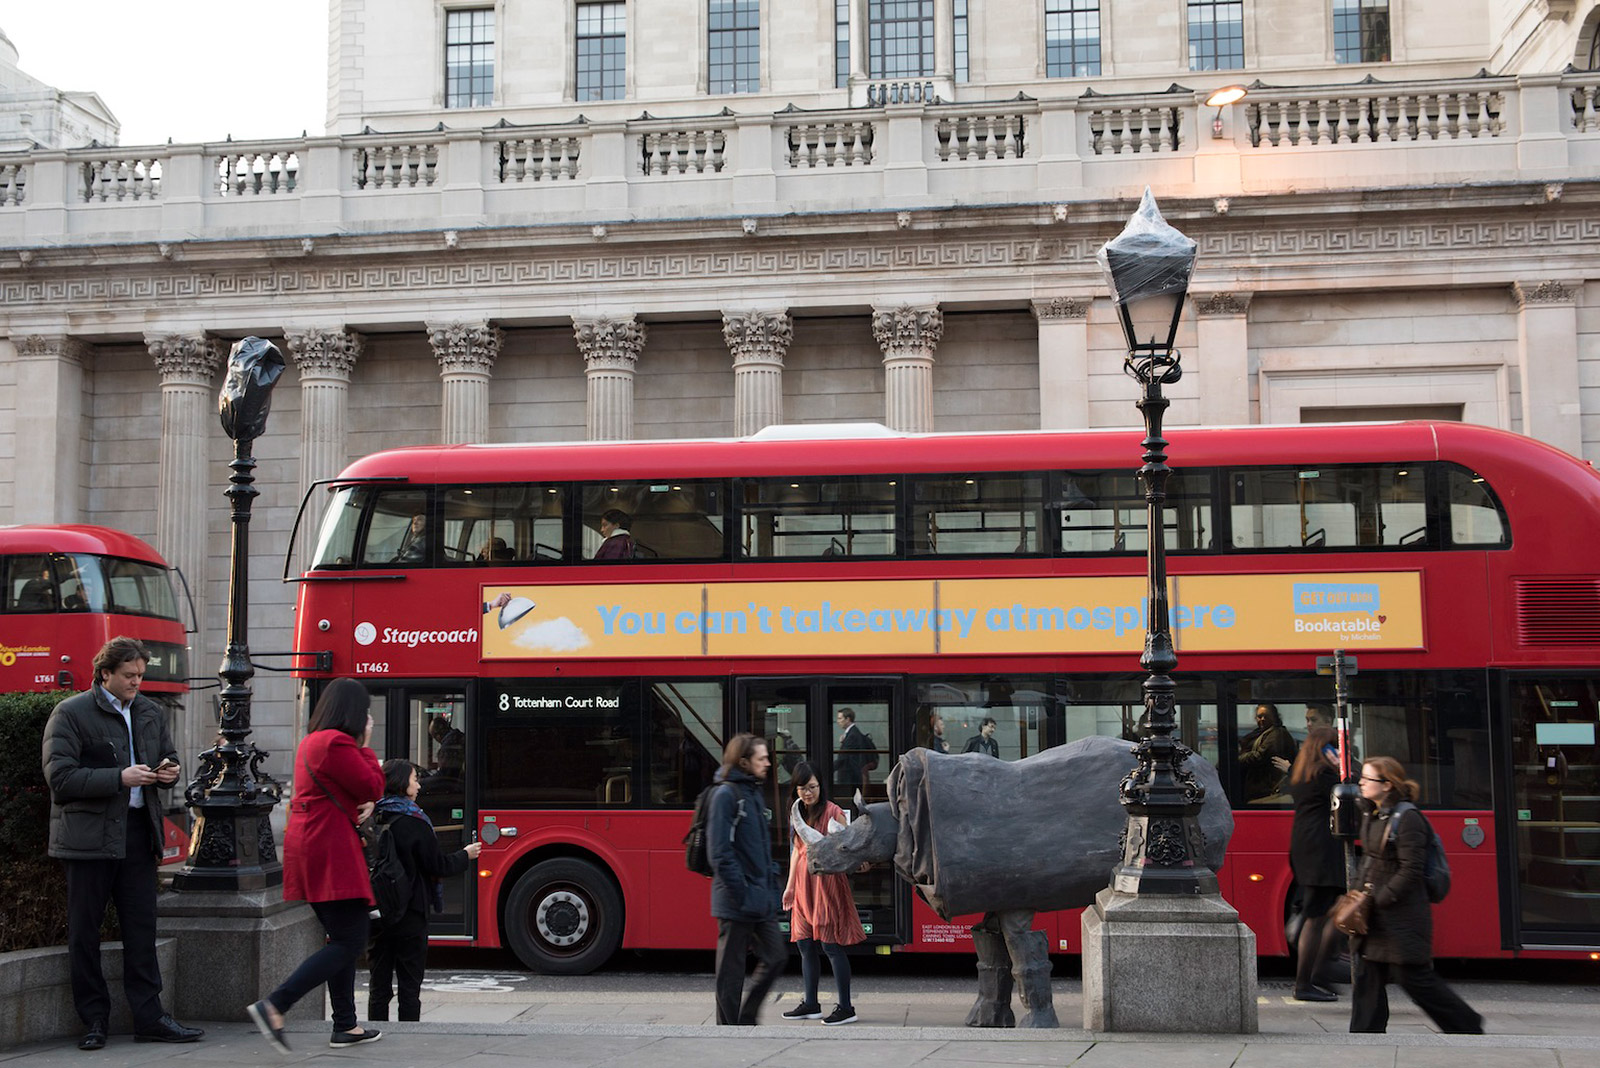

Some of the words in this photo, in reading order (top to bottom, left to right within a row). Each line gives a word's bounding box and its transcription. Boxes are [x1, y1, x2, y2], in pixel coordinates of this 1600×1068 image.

[1300, 592, 1325, 605] GET
[1326, 592, 1348, 604] OUT
[596, 605, 666, 635] You
[674, 601, 773, 635] can't
[779, 601, 979, 638] takeaway
[1294, 618, 1381, 632] Bookatable
[381, 627, 478, 648] Stagecoach
[1351, 633, 1382, 641] Michelin
[356, 662, 389, 673] LT462
[35, 674, 54, 683] LT61
[499, 692, 510, 711] 8
[512, 696, 562, 708] Tottenham
[564, 696, 593, 708] Court
[596, 696, 620, 708] Road
